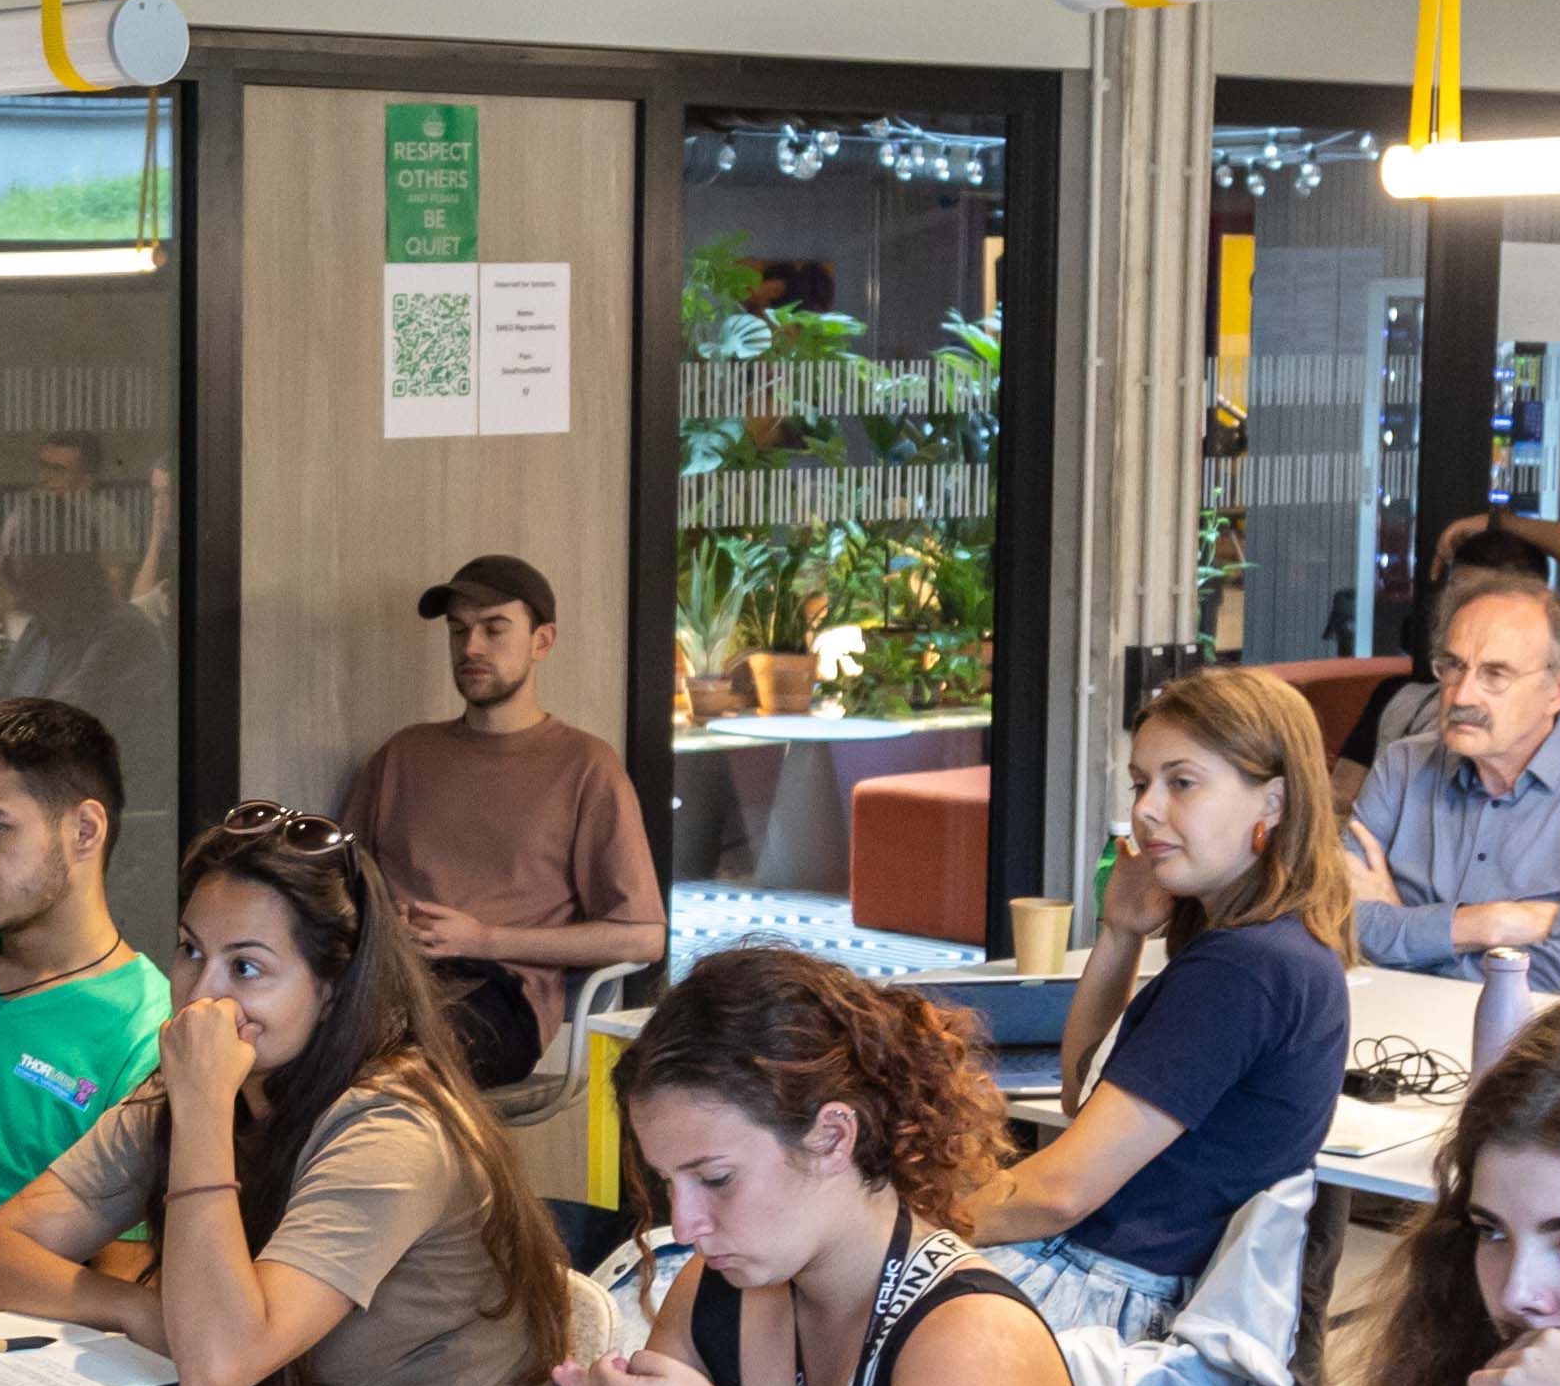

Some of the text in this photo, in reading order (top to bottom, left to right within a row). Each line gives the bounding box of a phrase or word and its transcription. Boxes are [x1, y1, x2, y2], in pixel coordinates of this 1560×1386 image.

[393, 141, 472, 162] RESPECT
[398, 169, 468, 188] OTHERS
[424, 209, 446, 229] BE
[405, 236, 462, 256] QUIET
